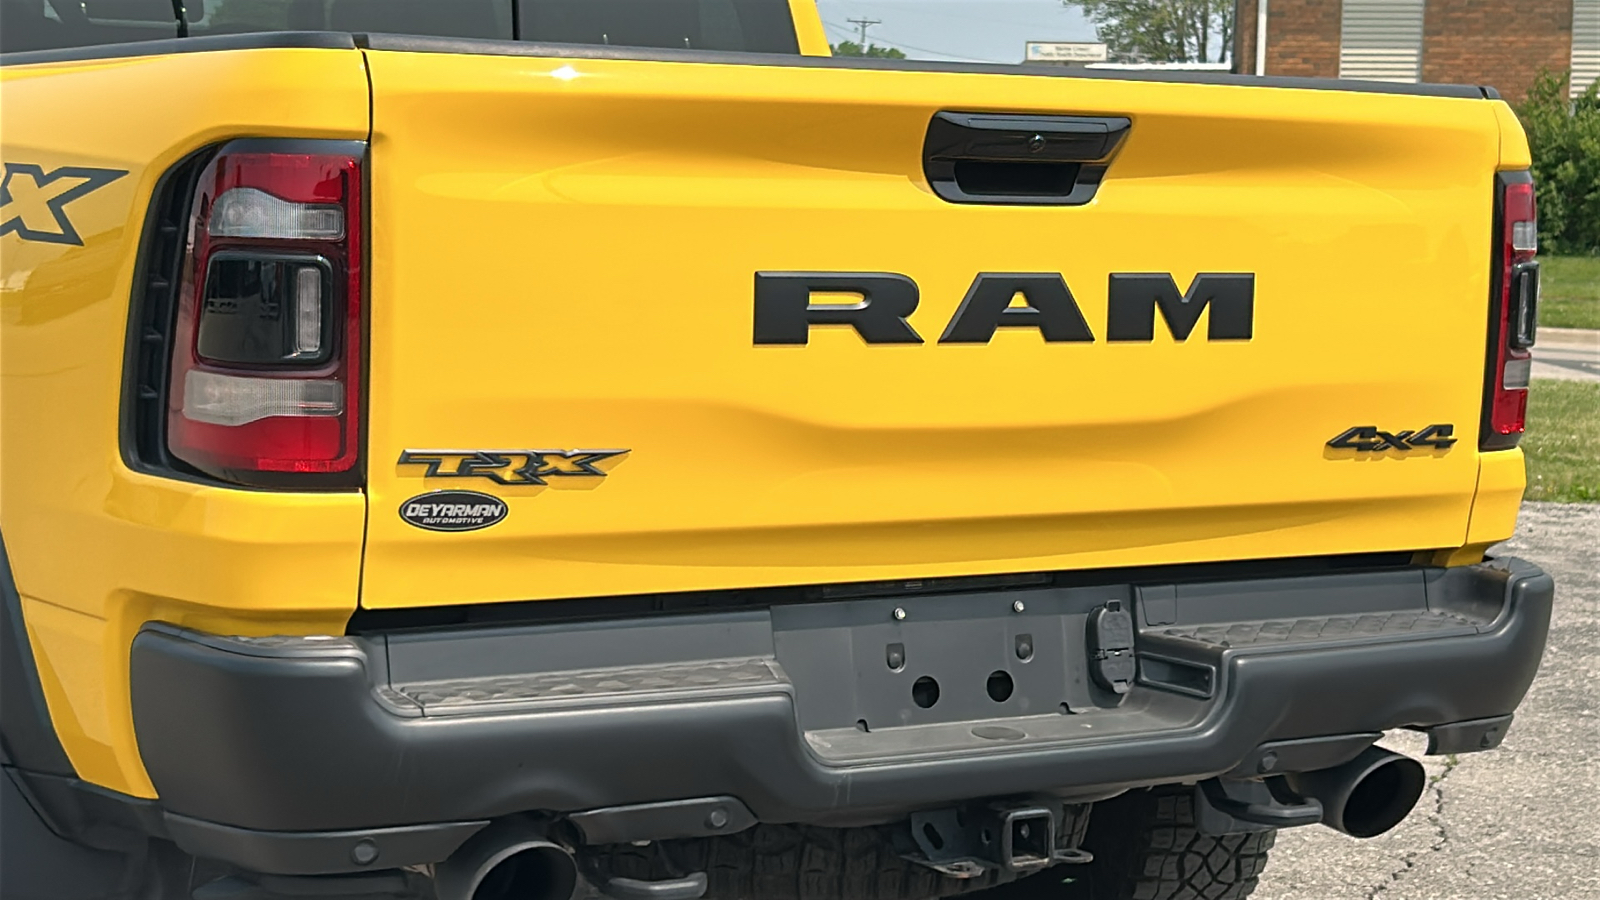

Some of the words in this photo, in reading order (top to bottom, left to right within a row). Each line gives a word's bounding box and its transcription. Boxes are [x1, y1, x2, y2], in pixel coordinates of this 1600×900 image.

[753, 270, 1256, 346] RAM
[1326, 423, 1458, 452] 4x4
[398, 448, 632, 486] TRX
[405, 503, 503, 517] DEYARMAN
